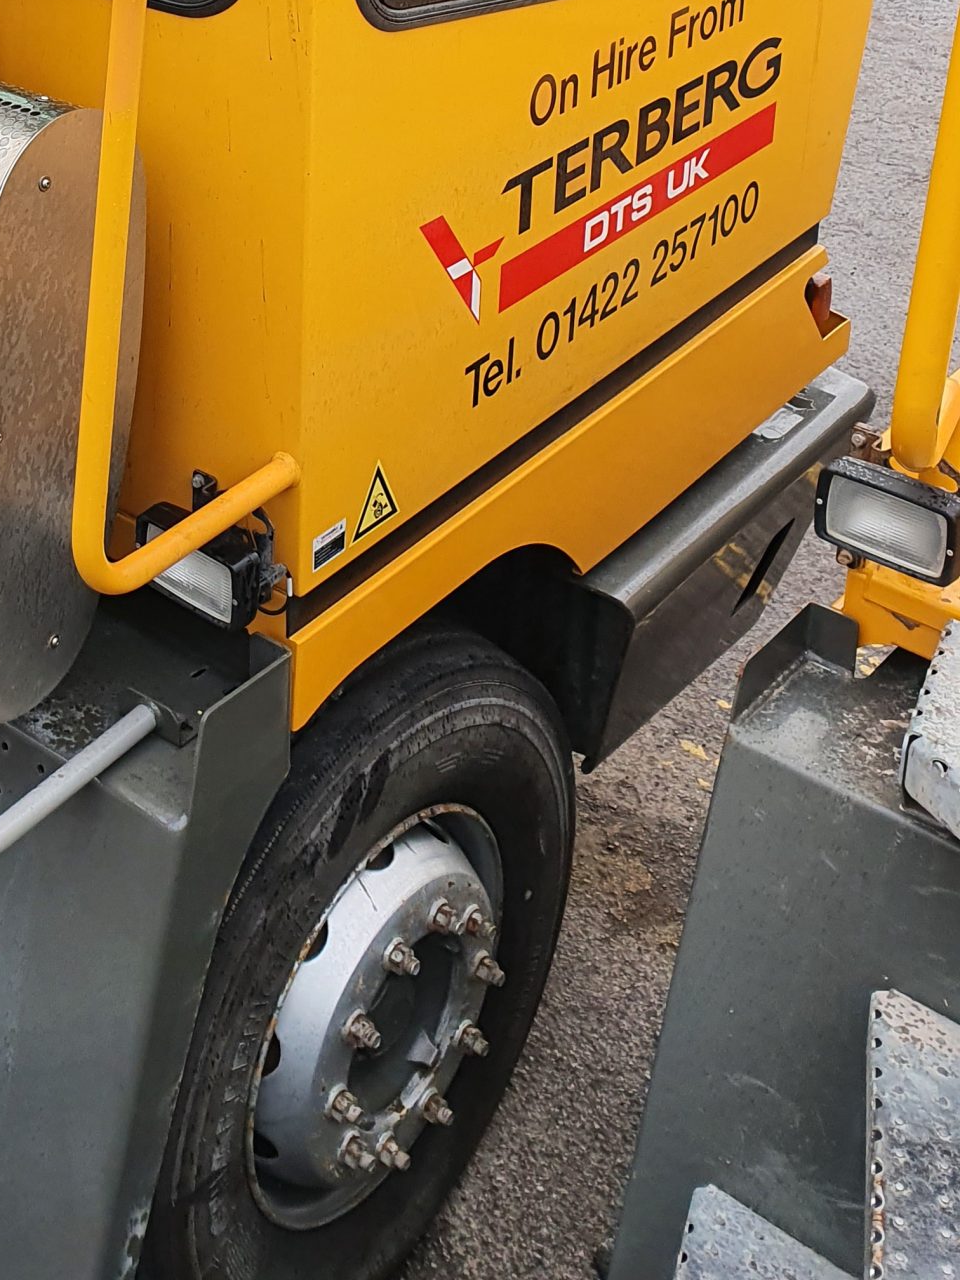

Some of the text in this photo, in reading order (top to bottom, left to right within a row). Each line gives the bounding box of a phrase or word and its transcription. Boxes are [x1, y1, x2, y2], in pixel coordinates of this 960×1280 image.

[501, 37, 783, 235] TERBERG
[530, 73, 579, 127] On
[591, 35, 657, 99] Hire
[583, 148, 711, 253] DTS UK
[464, 181, 759, 409] Tel. 01422 257100
